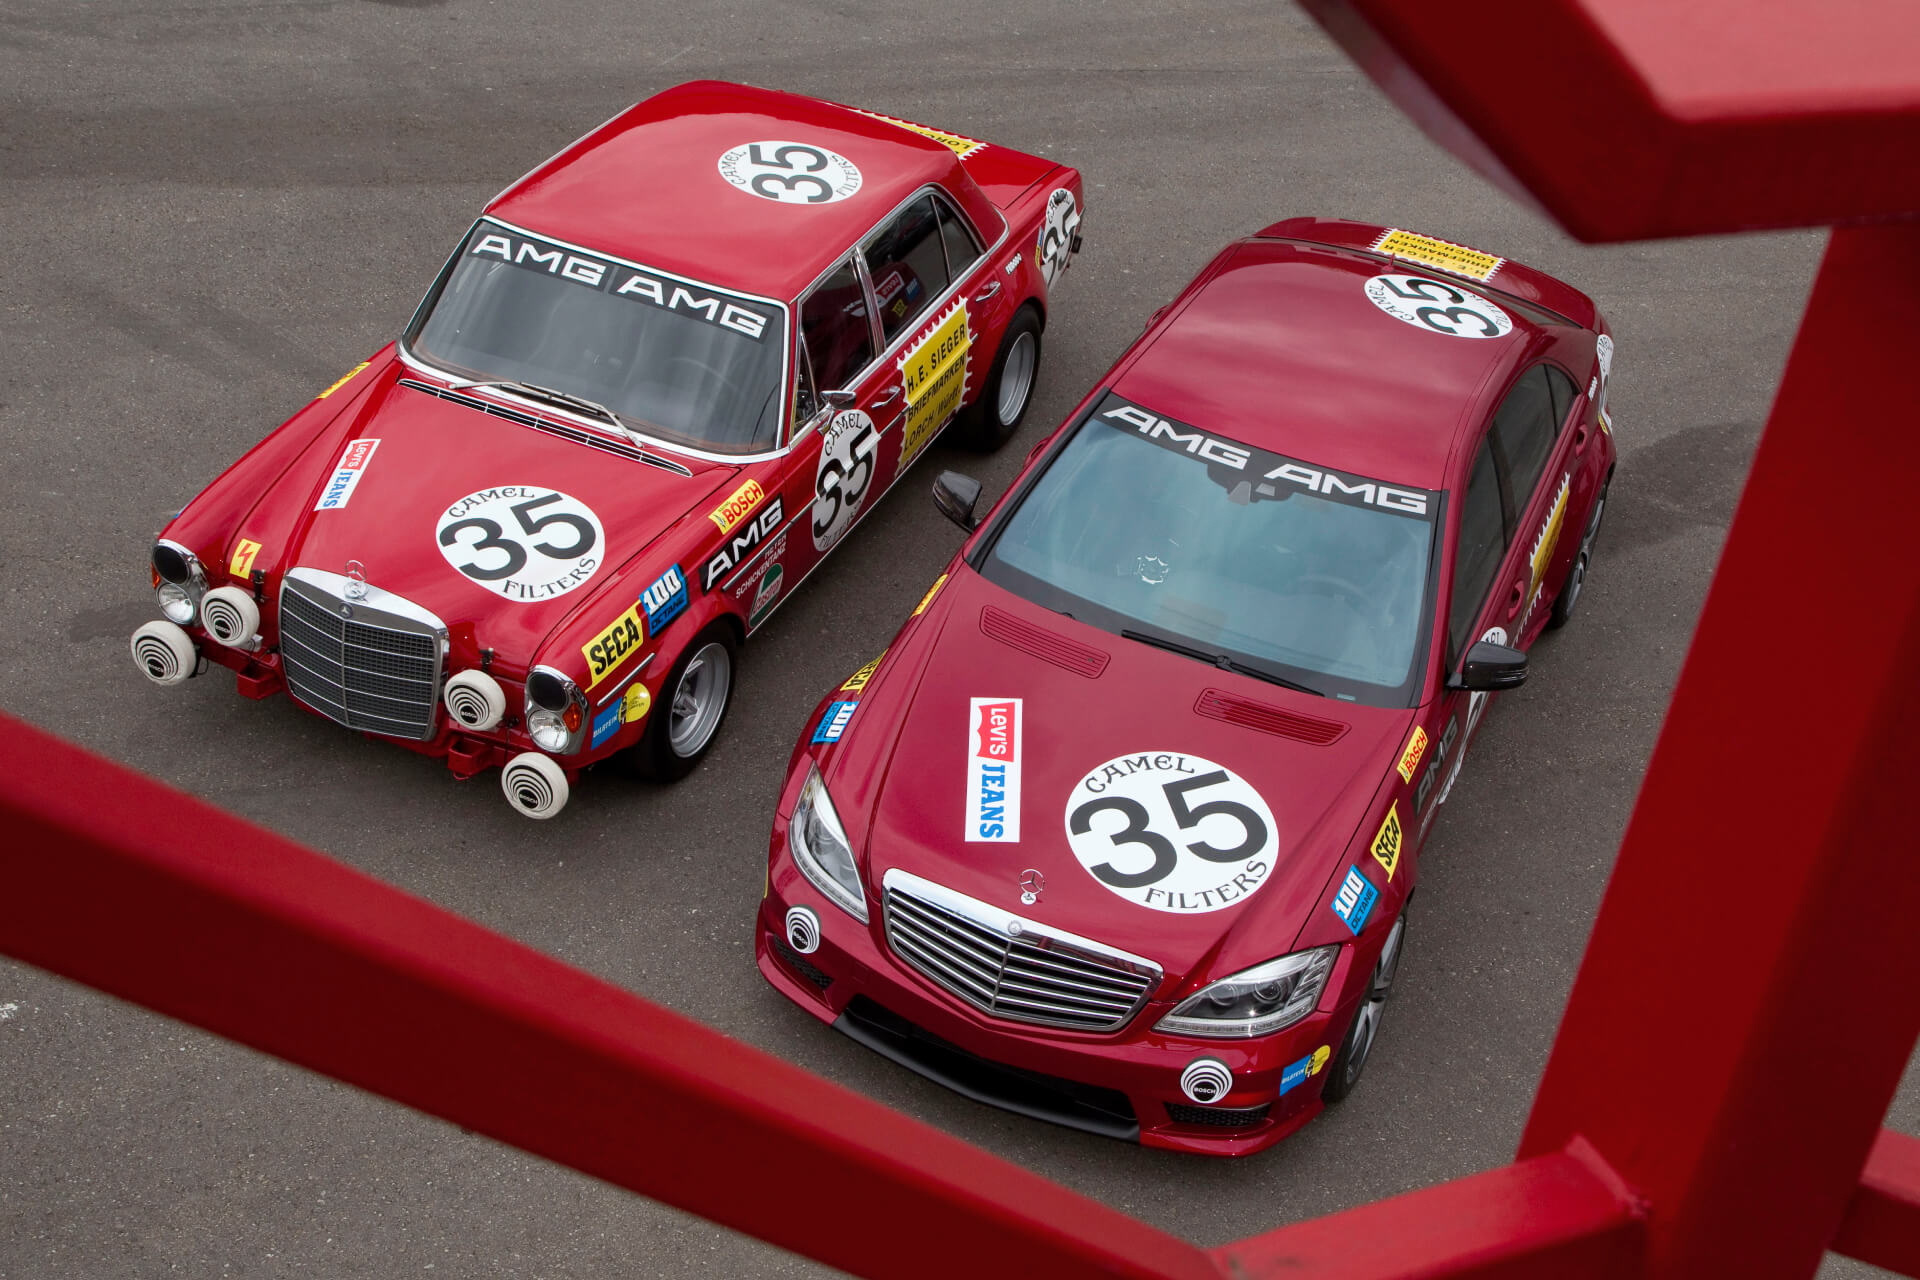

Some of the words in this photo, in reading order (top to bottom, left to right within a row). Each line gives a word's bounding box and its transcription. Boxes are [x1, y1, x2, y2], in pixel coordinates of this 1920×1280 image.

[721, 150, 747, 186] CAMEL
[749, 144, 834, 203] 35
[830, 154, 860, 197] FILTERS
[1384, 244, 1445, 264] SIEGER
[1389, 238, 1490, 269] BRIEFMARKEN
[472, 234, 606, 286] AMG
[616, 274, 767, 339] AMG
[1368, 285, 1415, 321] CAMEL
[1377, 277, 1500, 337] 35
[931, 323, 966, 370] SIEGER
[825, 412, 862, 456] CAMEL
[813, 422, 873, 539] 35
[1103, 405, 1251, 471] AMG
[1263, 463, 1427, 515] AMG
[322, 471, 354, 507] JEANS
[448, 487, 535, 518] CAMEL
[722, 482, 763, 525] BOSCH
[439, 493, 596, 581] 35
[706, 497, 783, 591] AMG
[503, 557, 596, 598] FILTERS
[643, 568, 682, 615] 100
[652, 594, 685, 629] OCTANE
[589, 616, 640, 676] SECA
[846, 661, 877, 687] ECA
[825, 703, 856, 738] 100
[1085, 754, 1195, 793] CAMEL
[1404, 732, 1427, 775] BOSCH
[1417, 714, 1458, 816] AMG
[979, 763, 1006, 839] JEANS
[1069, 769, 1268, 889] 35
[1375, 815, 1400, 867] SECA
[1144, 859, 1267, 909] FILTERS
[1334, 870, 1365, 920] 100
[1351, 888, 1374, 929] OCTANE
